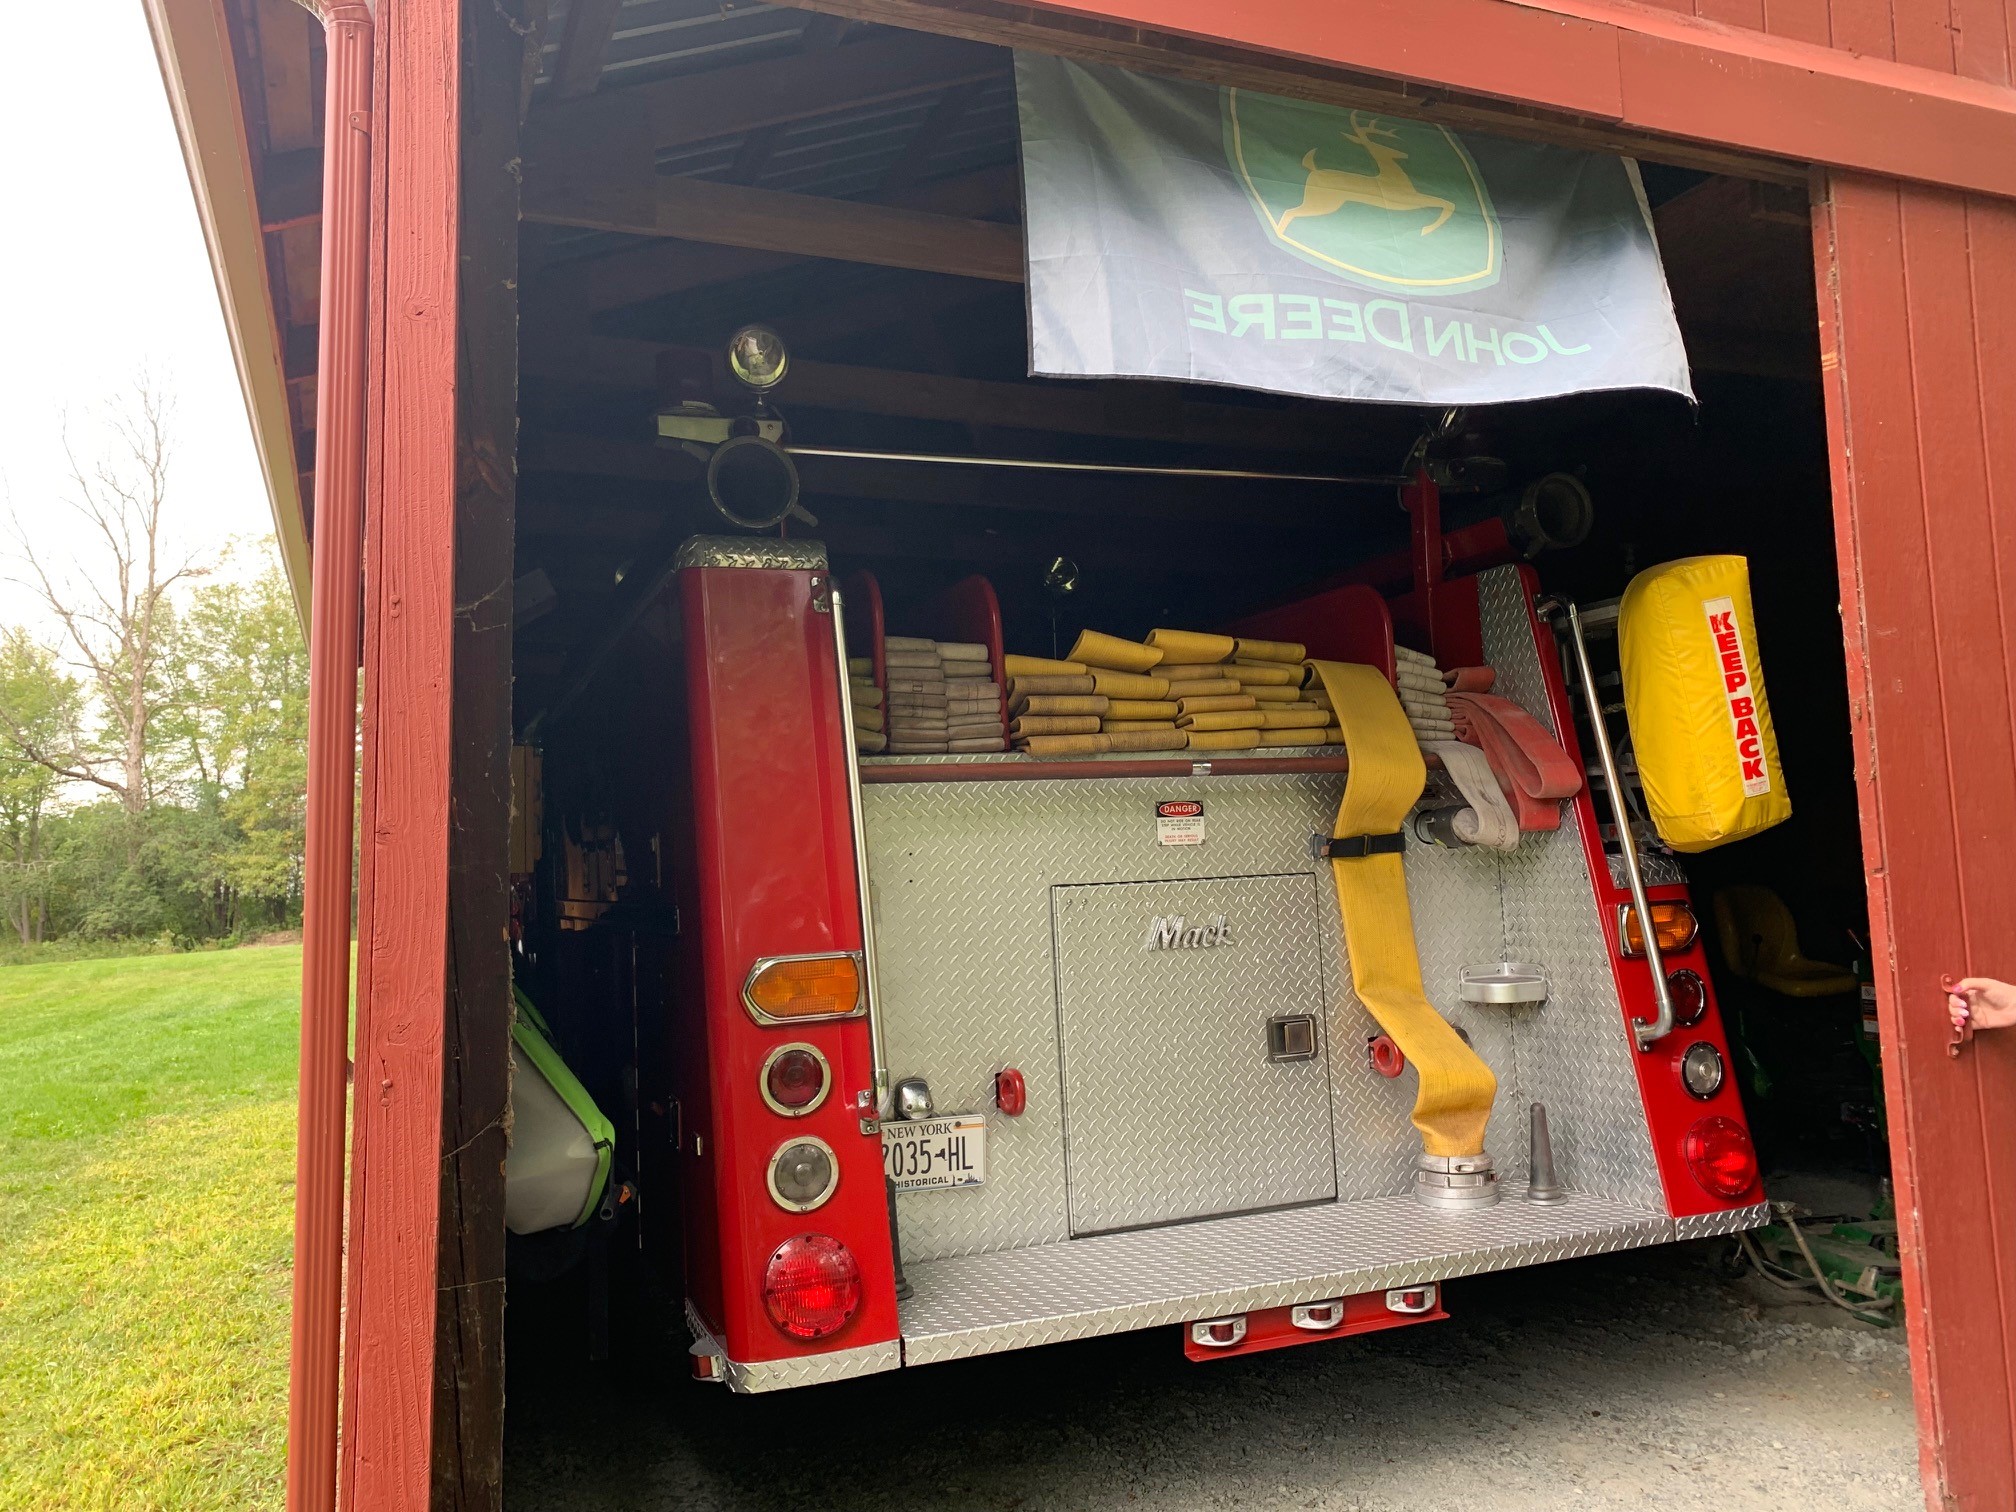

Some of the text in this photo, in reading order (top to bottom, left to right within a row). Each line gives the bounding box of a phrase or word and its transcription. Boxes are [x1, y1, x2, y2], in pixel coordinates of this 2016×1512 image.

[1709, 611, 1747, 694] KEEP
[1731, 696, 1765, 781] BACK
[1164, 805, 1197, 813] DANGER
[1148, 914, 1236, 952] Mack
[887, 1122, 952, 1140] NEW YORK
[896, 1176, 948, 1188] HISTORICAL
